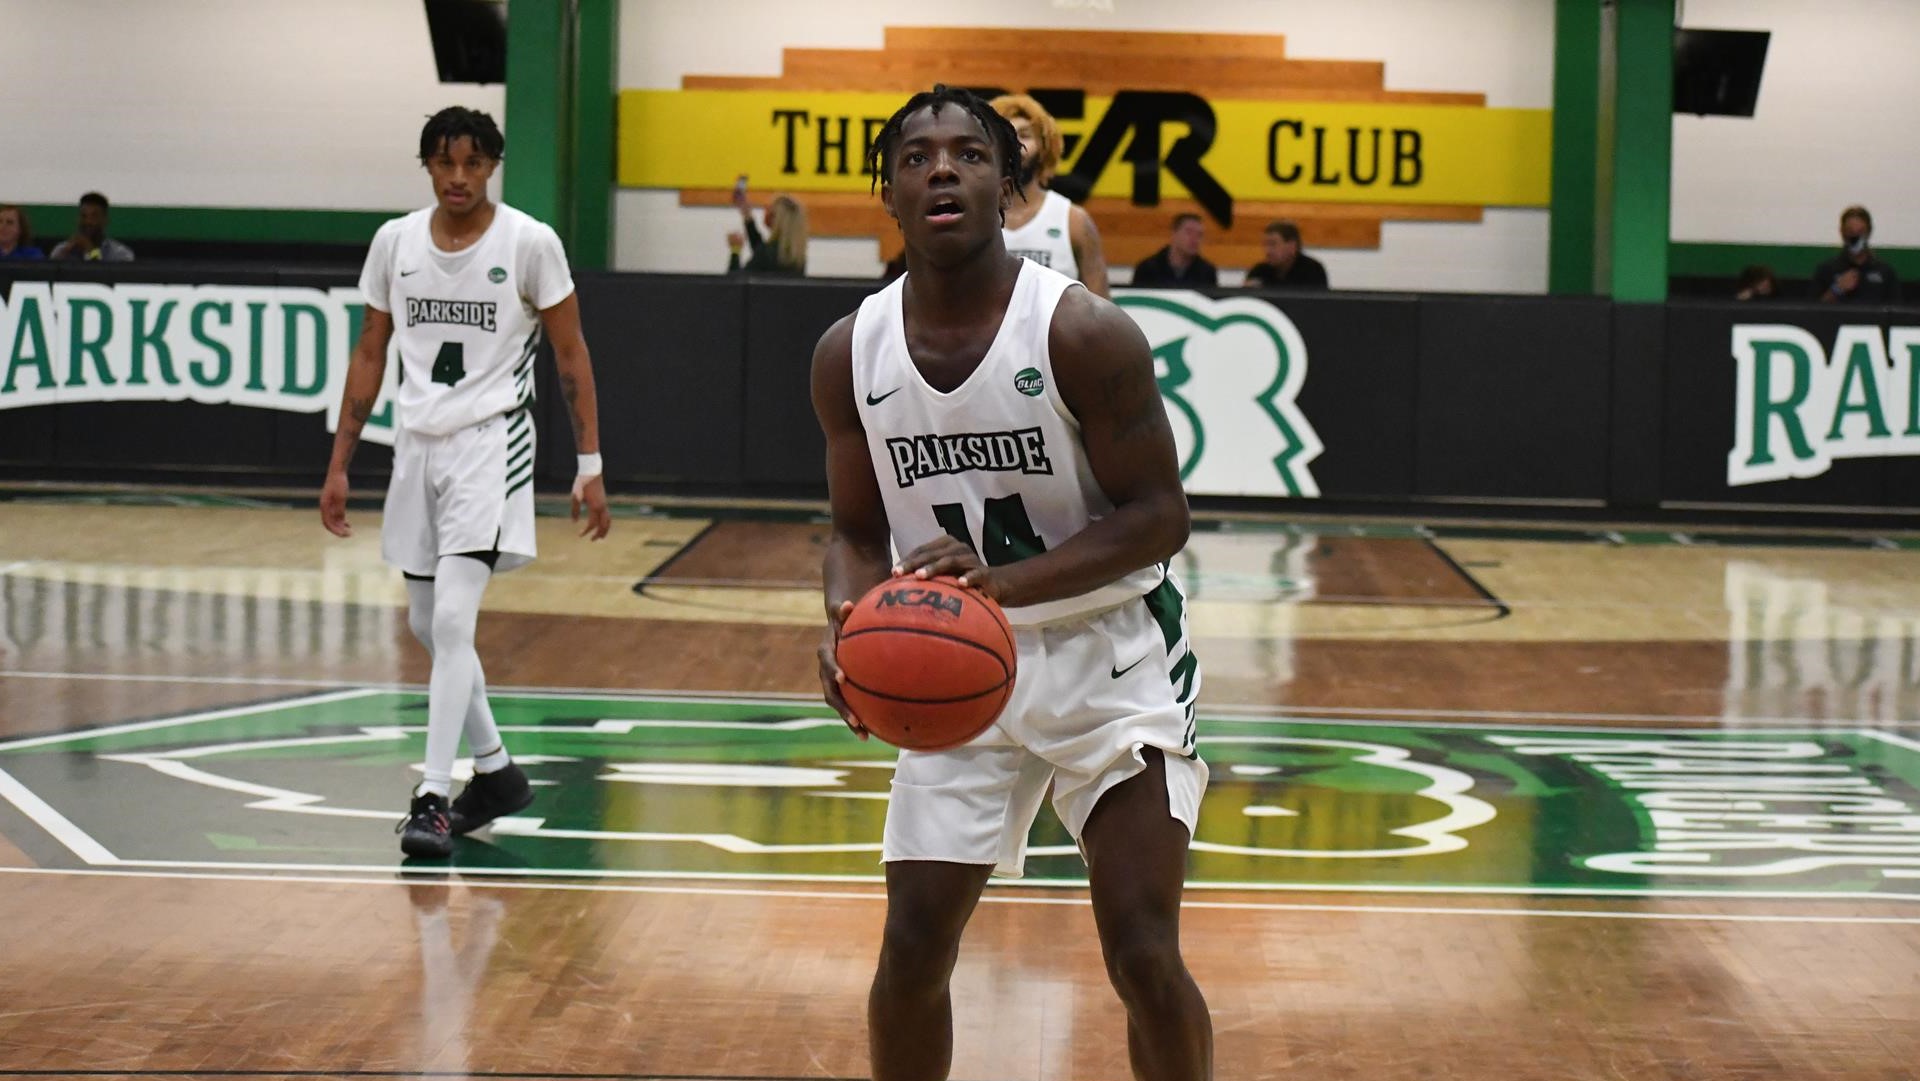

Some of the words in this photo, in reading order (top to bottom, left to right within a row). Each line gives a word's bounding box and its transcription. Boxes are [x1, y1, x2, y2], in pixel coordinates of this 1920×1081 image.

[1268, 119, 1423, 187] CLUB
[406, 297, 497, 333] PARKSIDE
[431, 342, 466, 387] 4
[886, 426, 1053, 488] PARKSIDE
[932, 493, 1047, 567] 14
[876, 589, 963, 618] NCAA
